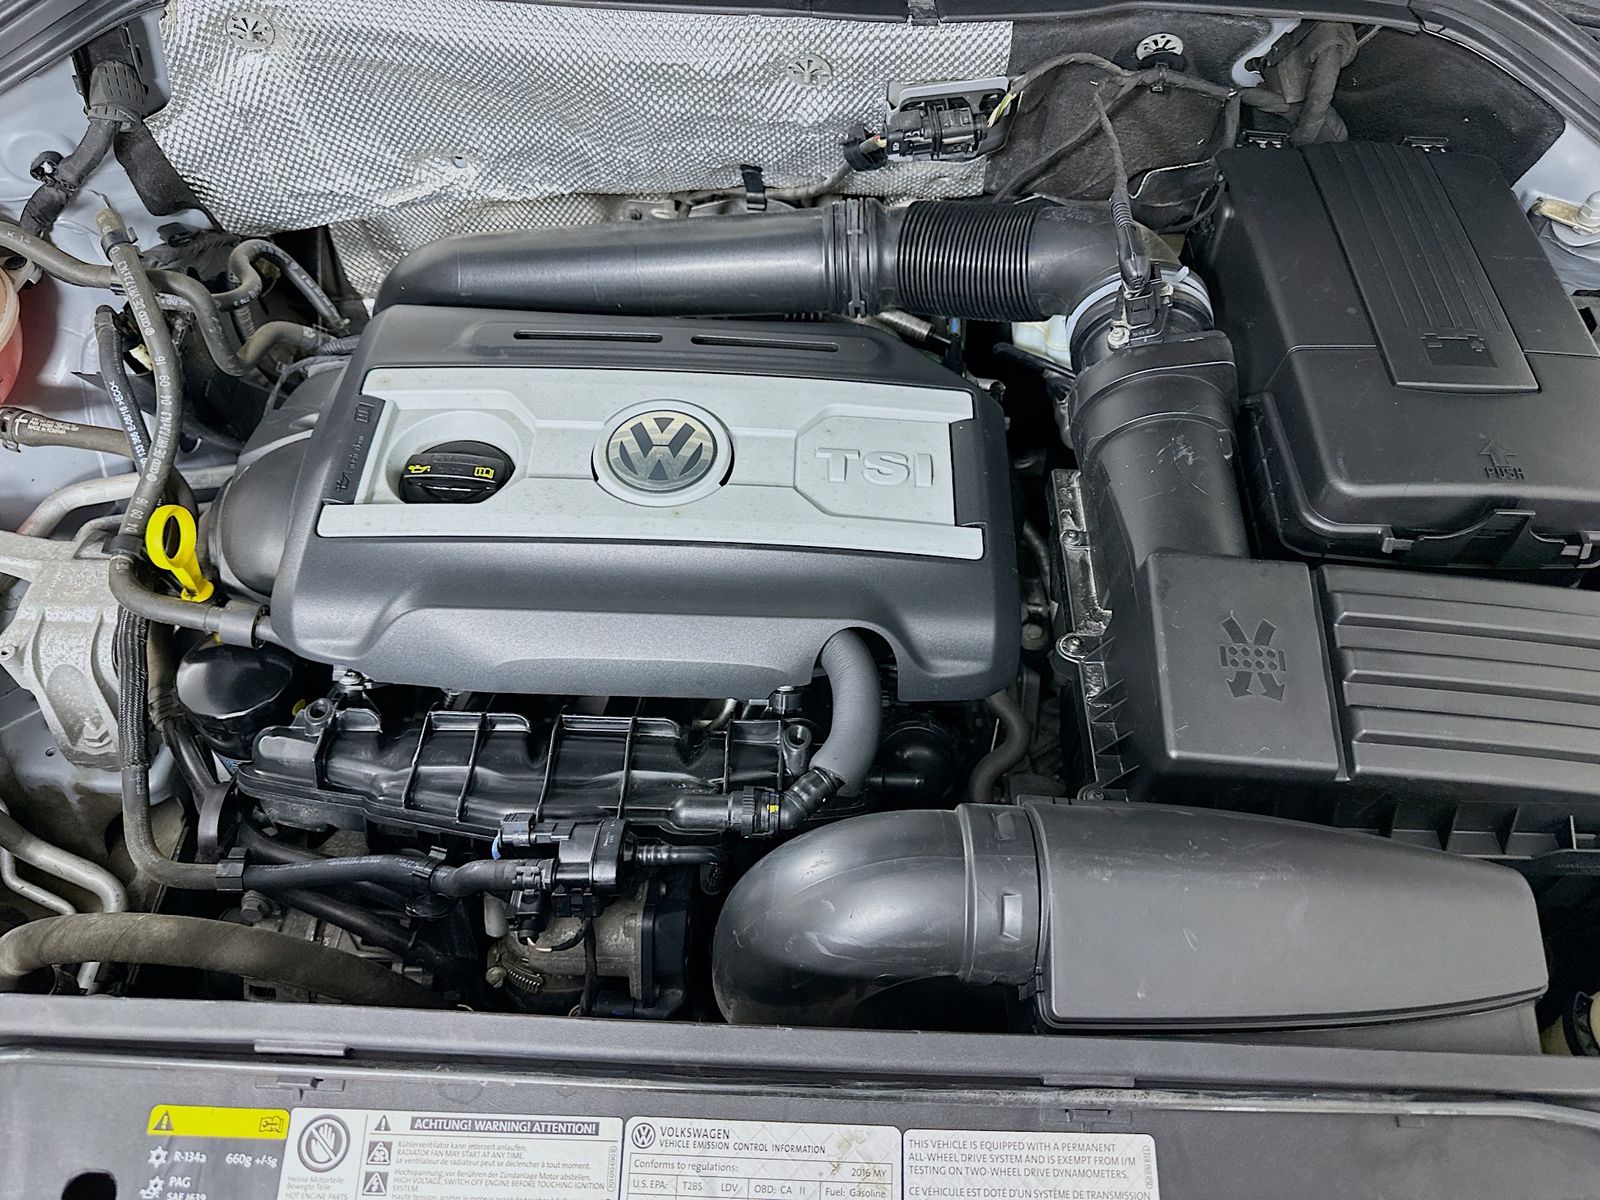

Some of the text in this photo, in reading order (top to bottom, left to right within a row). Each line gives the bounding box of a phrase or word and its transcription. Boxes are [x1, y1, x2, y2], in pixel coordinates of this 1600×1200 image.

[154, 355, 167, 366] 16
[159, 375, 171, 387] 09
[814, 446, 934, 487] TSI
[1484, 466, 1525, 480] PUSH
[414, 1118, 596, 1134] ACHTUNG! WARNING! ATTENTION!
[660, 1126, 730, 1140] VOLKSWAGEN
[660, 1139, 826, 1154] VEHICLE EMISSION CONTROL INFORMATION
[909, 1139, 1117, 1153] THIS VEHICLE IS EQUIPPED WITH A PERMANENT
[173, 1151, 207, 1163] R-134a
[225, 1153, 252, 1168] 660g
[445, 1150, 460, 1158] MAY
[461, 1151, 481, 1159] START
[908, 1152, 1136, 1166] ALL-WHEEL DRIVE SYSTEM AND IS EXEMPT FROM I/M
[634, 1159, 738, 1173] Conforms to regulations:
[909, 1165, 1129, 1179] TESTING ON TWO-WHEEL DRIVE DYNAMOMETERS.
[852, 1168, 887, 1178] 2016 MY
[168, 1176, 192, 1188] PAG
[444, 1178, 470, 1186] SWITCH
[471, 1179, 485, 1187] OFF
[485, 1179, 510, 1188] ENGINE
[511, 1180, 536, 1188] BEFORE
[537, 1180, 574, 1189] TOUCHING
[574, 1181, 605, 1190] IGNITION
[632, 1179, 649, 1189] U.S.
[721, 1183, 739, 1192] LDV
[754, 1185, 776, 1194] OBD:
[780, 1186, 793, 1194] CA
[825, 1188, 887, 1198] Fuel: Gasoline
[908, 1185, 1150, 1200] CE VÉHICULE EST DOTÉ D'UN SYSTÈME DE TRANSMISSION
